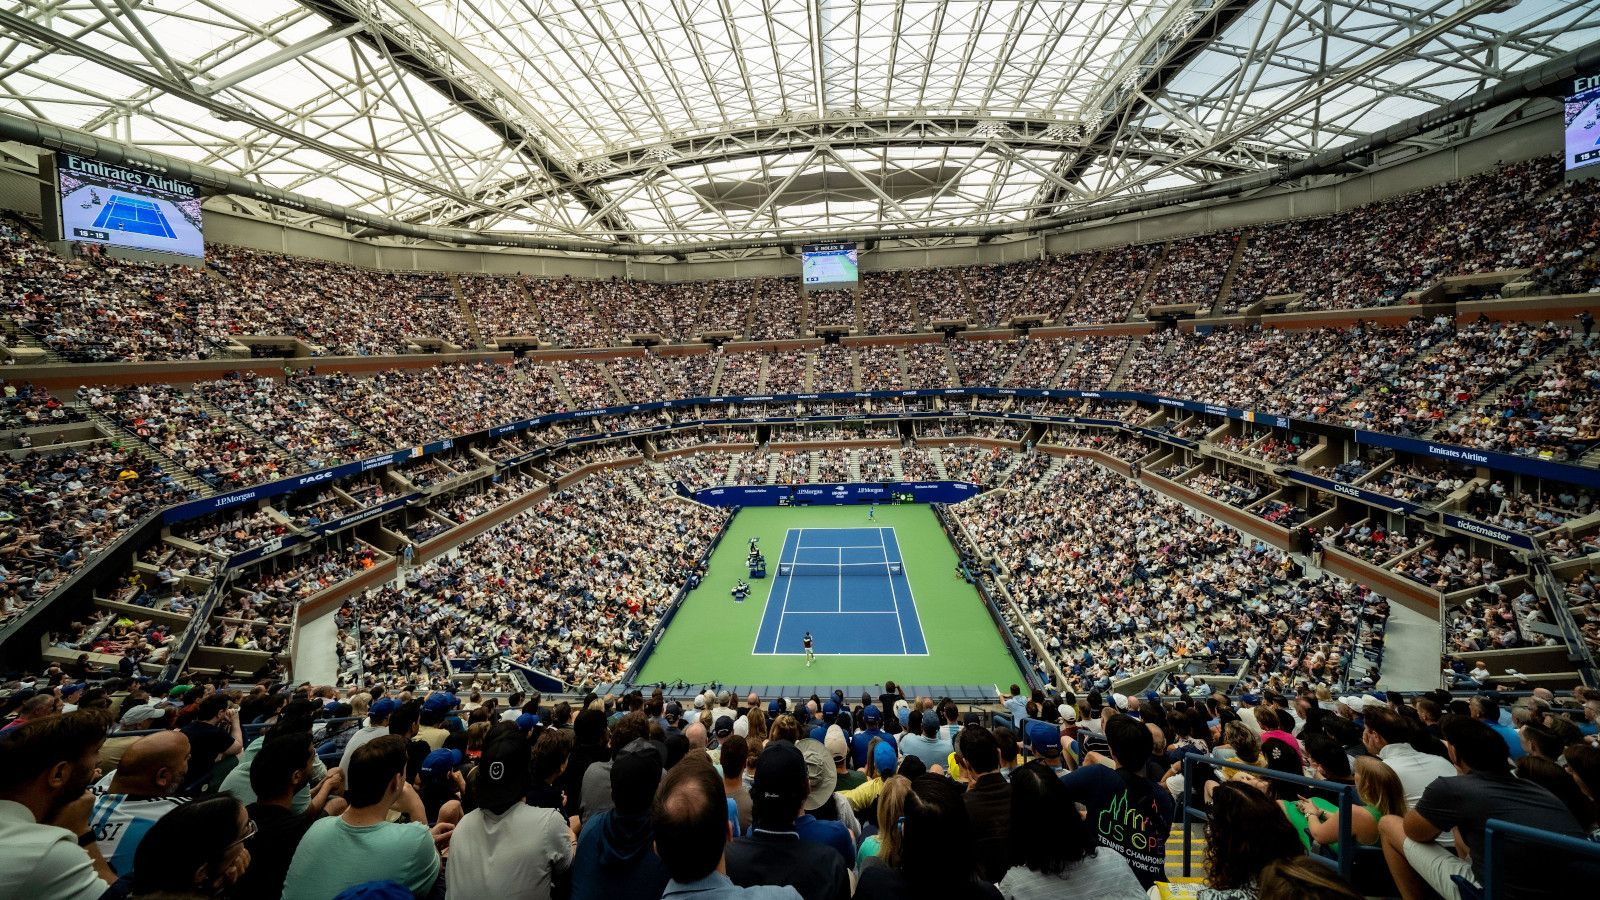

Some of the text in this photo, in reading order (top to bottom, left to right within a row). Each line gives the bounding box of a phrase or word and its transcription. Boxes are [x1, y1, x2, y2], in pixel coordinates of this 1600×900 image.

[68, 155, 195, 197] Emirates Airline
[1429, 445, 1488, 463] Emirates Airline
[1334, 484, 1360, 498] CHASE
[1457, 520, 1512, 542] ticketmaster
[1097, 833, 1125, 853] TENNIS
[1131, 860, 1149, 872] YORK
